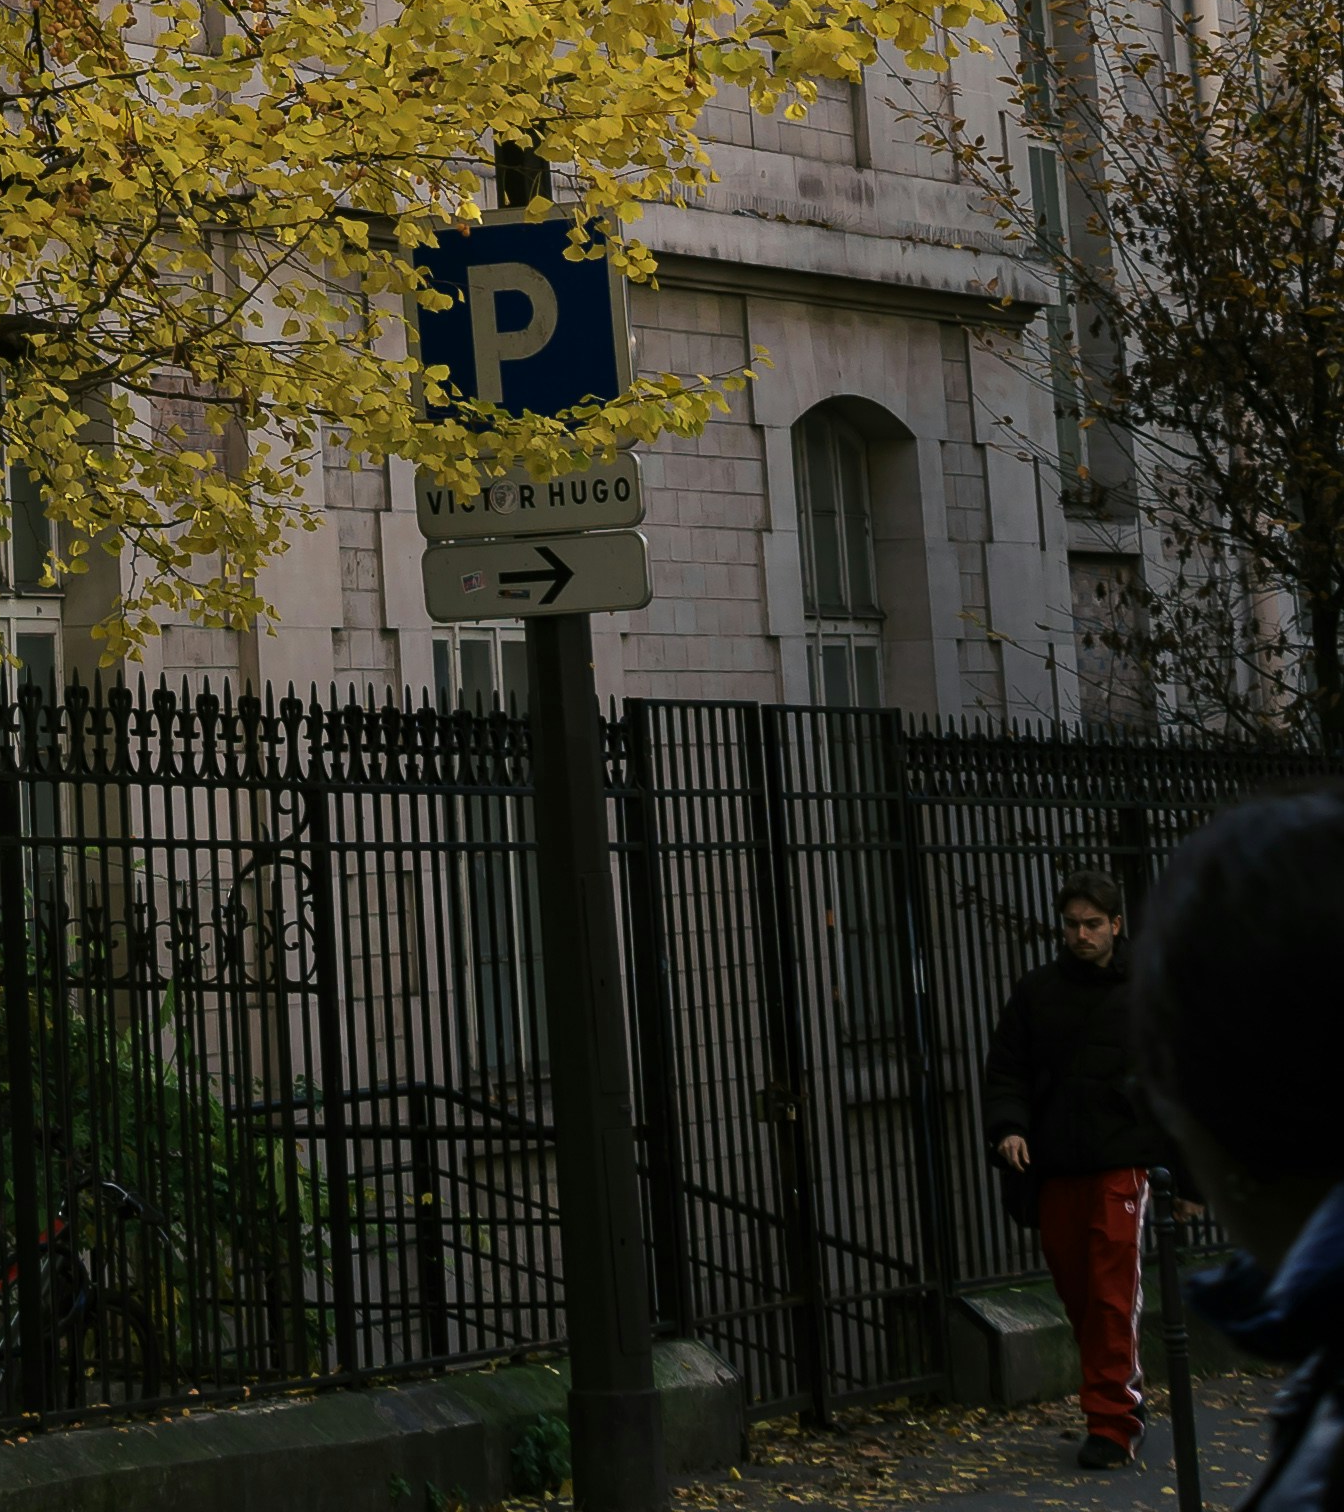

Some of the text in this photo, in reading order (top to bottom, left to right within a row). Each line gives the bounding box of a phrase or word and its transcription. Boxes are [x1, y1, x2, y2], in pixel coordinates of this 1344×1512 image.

[467, 262, 559, 403] P
[426, 476, 631, 515] VITR HUGO
